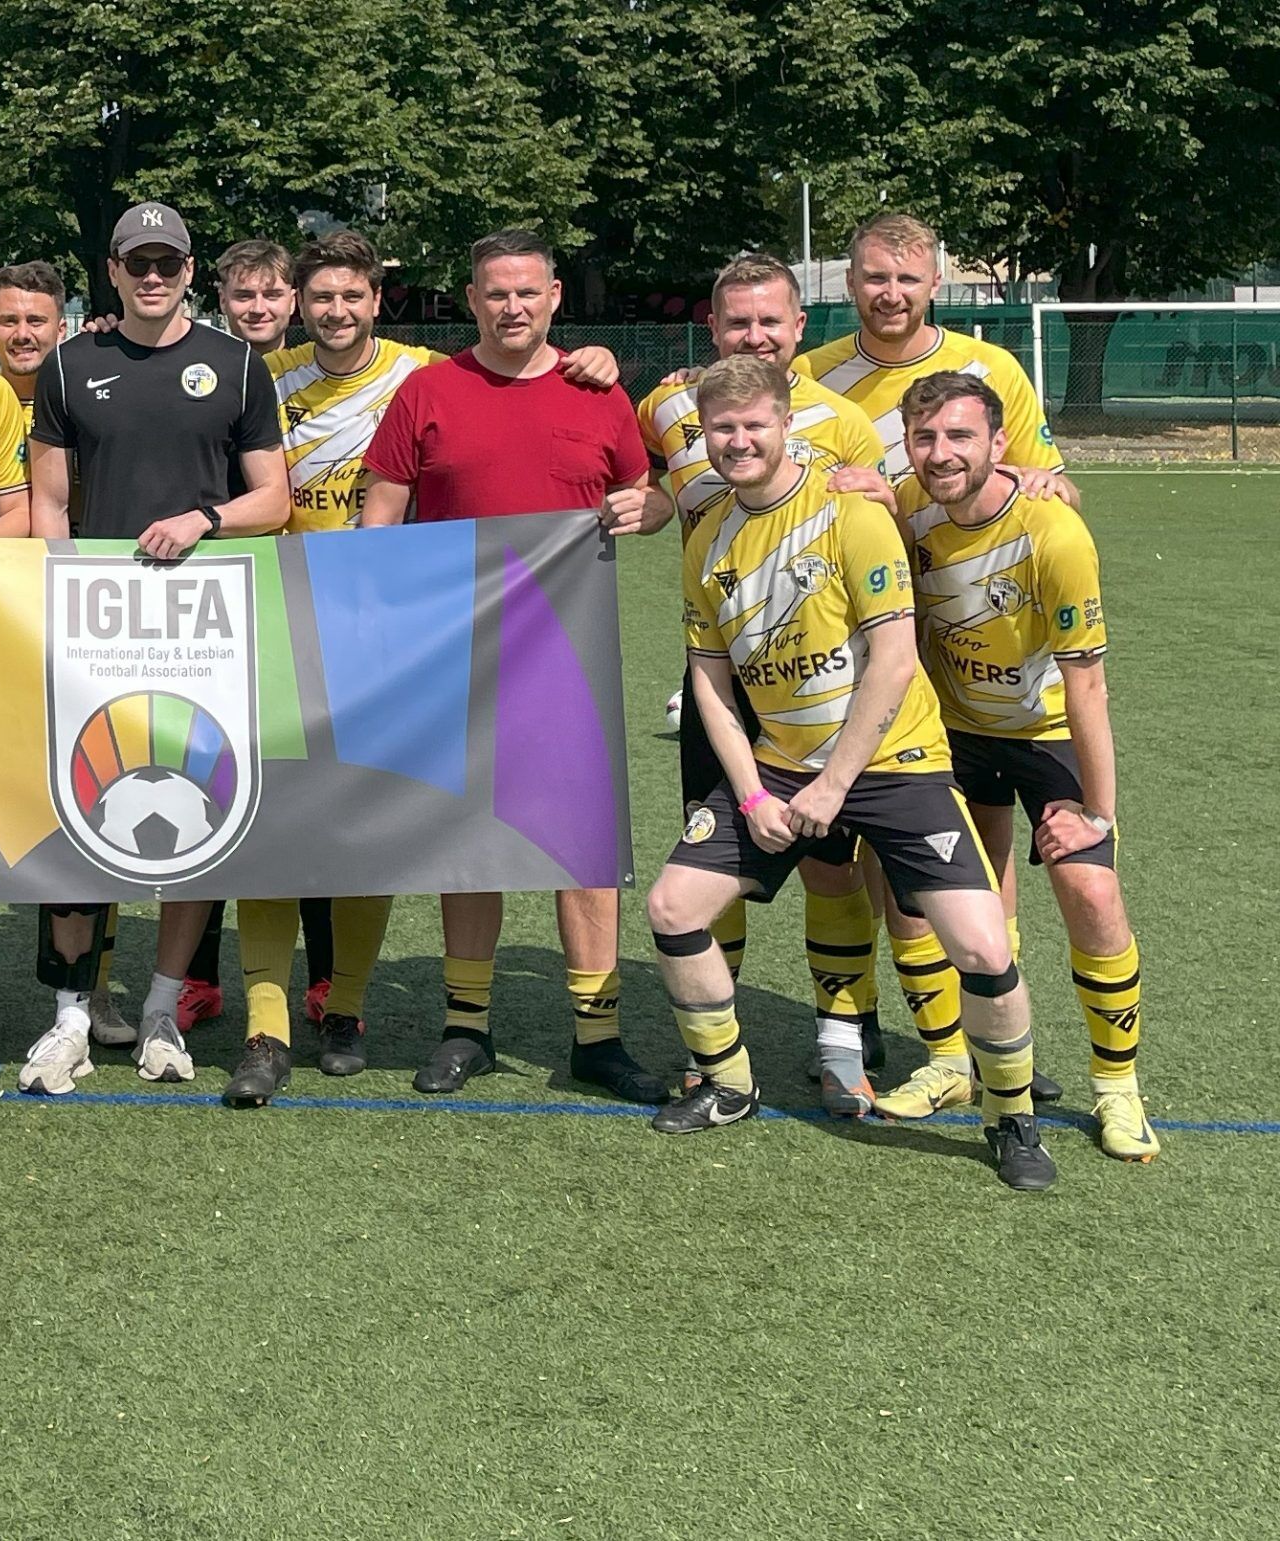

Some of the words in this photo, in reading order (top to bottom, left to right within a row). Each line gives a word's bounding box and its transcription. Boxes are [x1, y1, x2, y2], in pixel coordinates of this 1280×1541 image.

[95, 389, 111, 400] SC
[308, 456, 371, 486] Two
[293, 486, 368, 511] BREWE
[67, 578, 234, 640] IGLFA
[746, 619, 808, 659] Two
[932, 615, 990, 651] Two
[66, 646, 144, 660] International
[148, 647, 169, 663] Gay
[174, 648, 183, 660] &
[187, 646, 234, 660] Lesbian
[737, 646, 848, 687] BREWERS
[950, 650, 1021, 685] WERS
[89, 664, 137, 677] Football
[141, 664, 212, 678] Association
